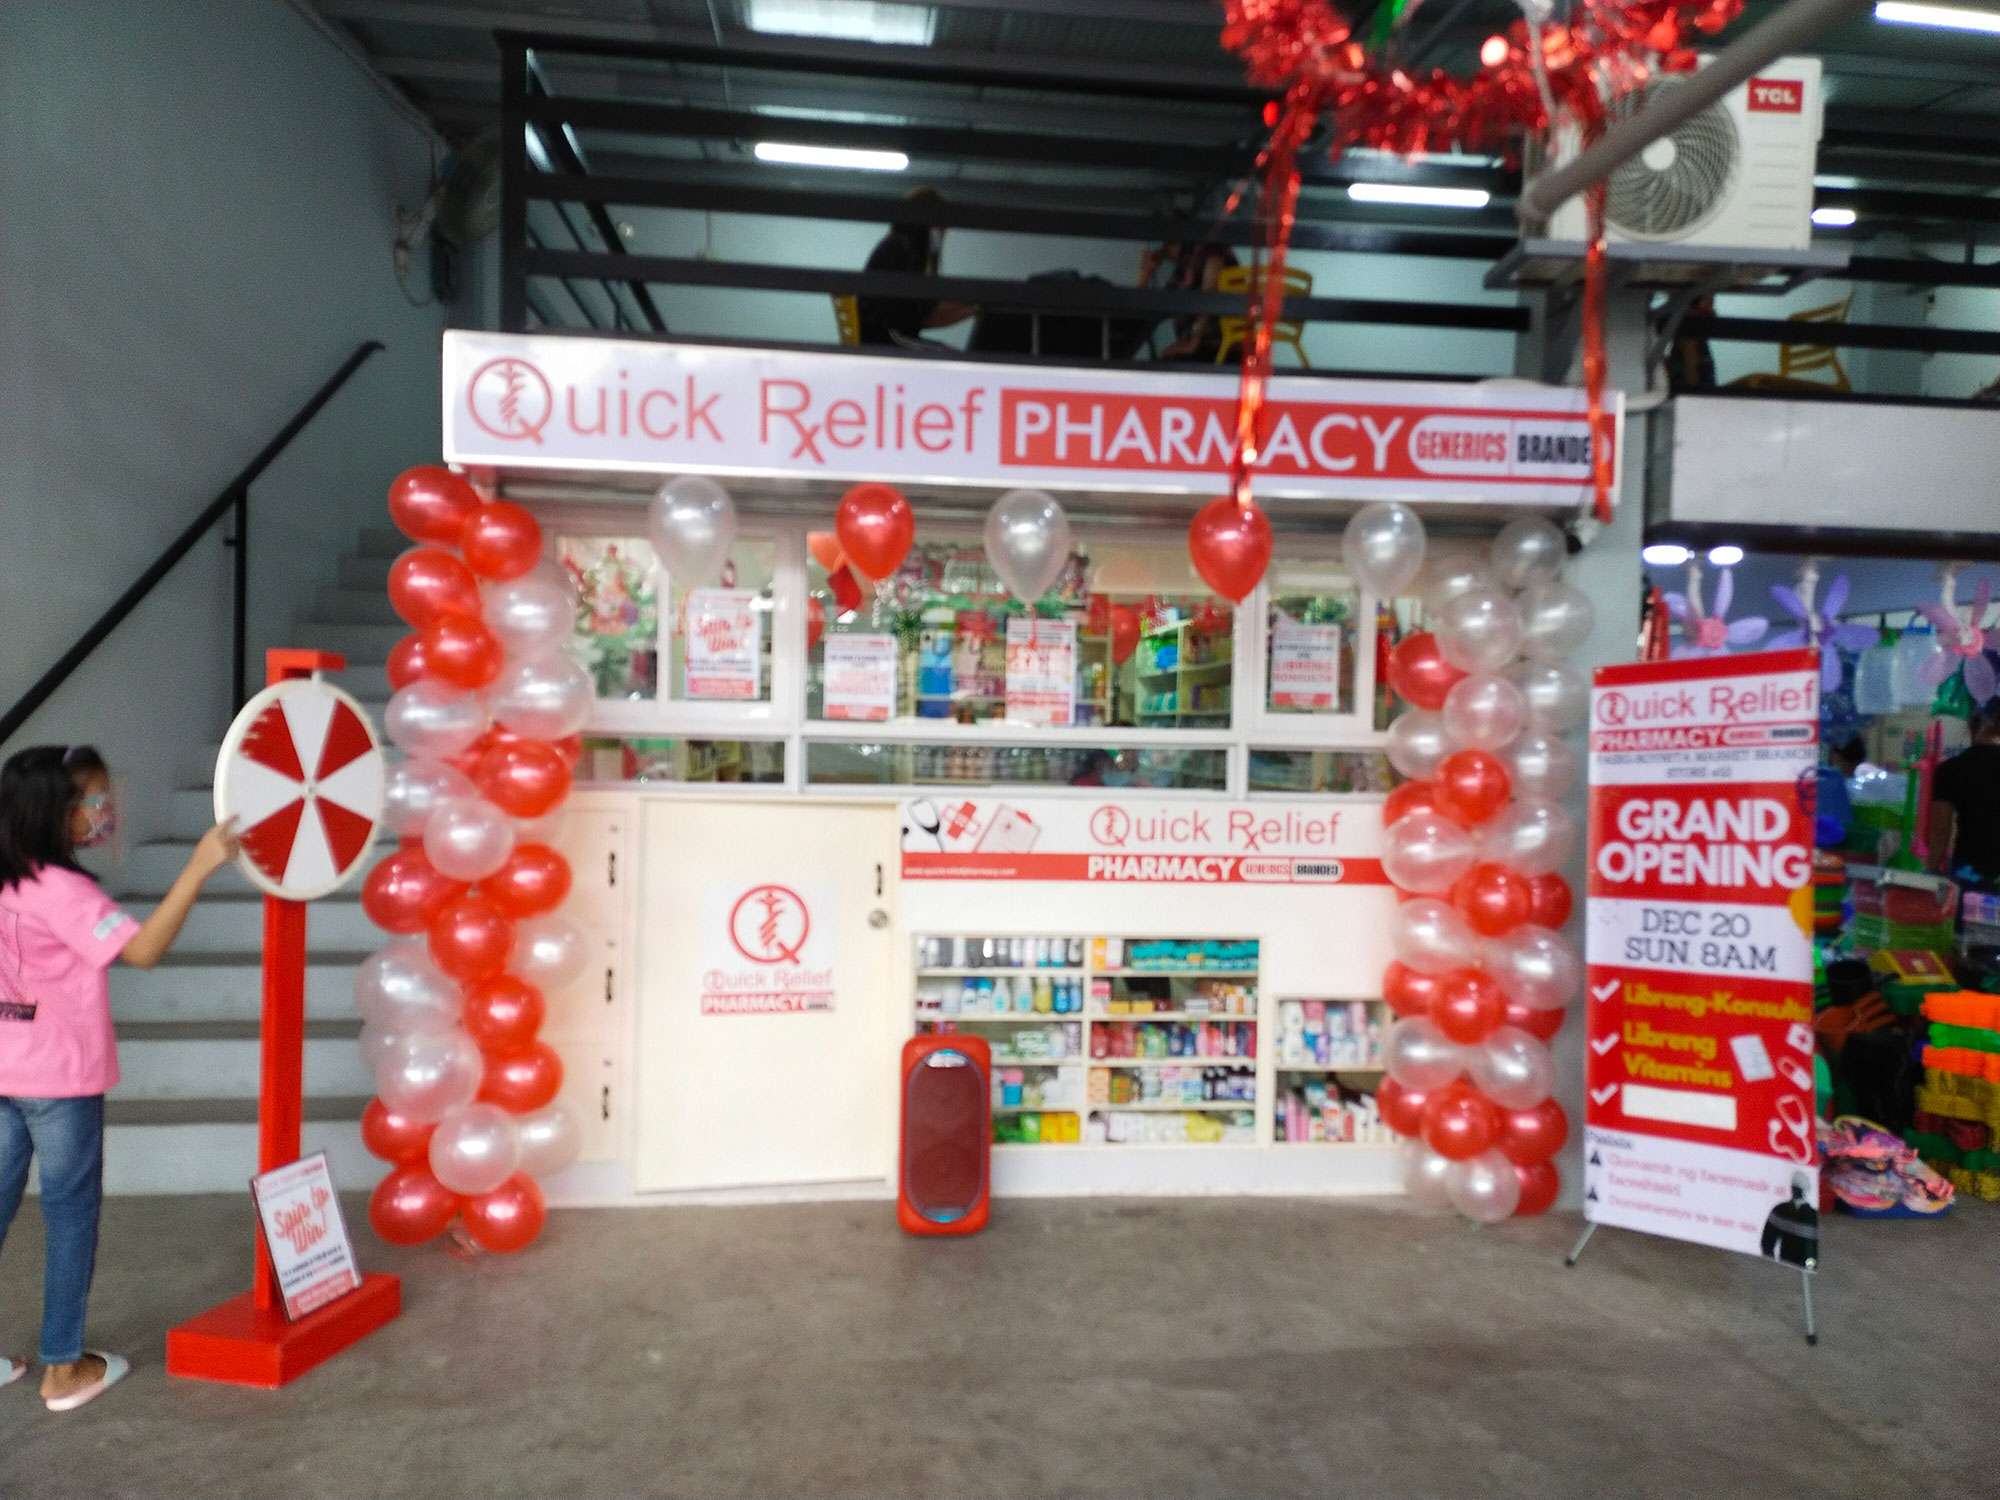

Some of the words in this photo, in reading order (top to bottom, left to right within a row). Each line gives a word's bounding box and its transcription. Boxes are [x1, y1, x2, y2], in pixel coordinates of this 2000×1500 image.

[1754, 87, 1797, 105] TCL
[467, 357, 723, 444] Quick
[1015, 401, 1404, 472] PHARMACY
[1416, 430, 1507, 462] GENERICS
[1517, 434, 1592, 465] BRANDE
[1596, 690, 1696, 726] Quick
[1600, 728, 1721, 751] PHARMACY
[1089, 804, 1212, 847] Quick
[1617, 798, 1791, 842] GRAND
[1087, 855, 1236, 881] PHARMACY
[1597, 841, 1812, 889] OPENING
[1642, 908, 1701, 935] DEC
[1710, 911, 1751, 938] 20
[1624, 936, 1690, 963] SUN
[1702, 942, 1777, 972] 8AM
[1622, 1021, 1717, 1060] Libreng
[1621, 1051, 1733, 1088] Vitamins
